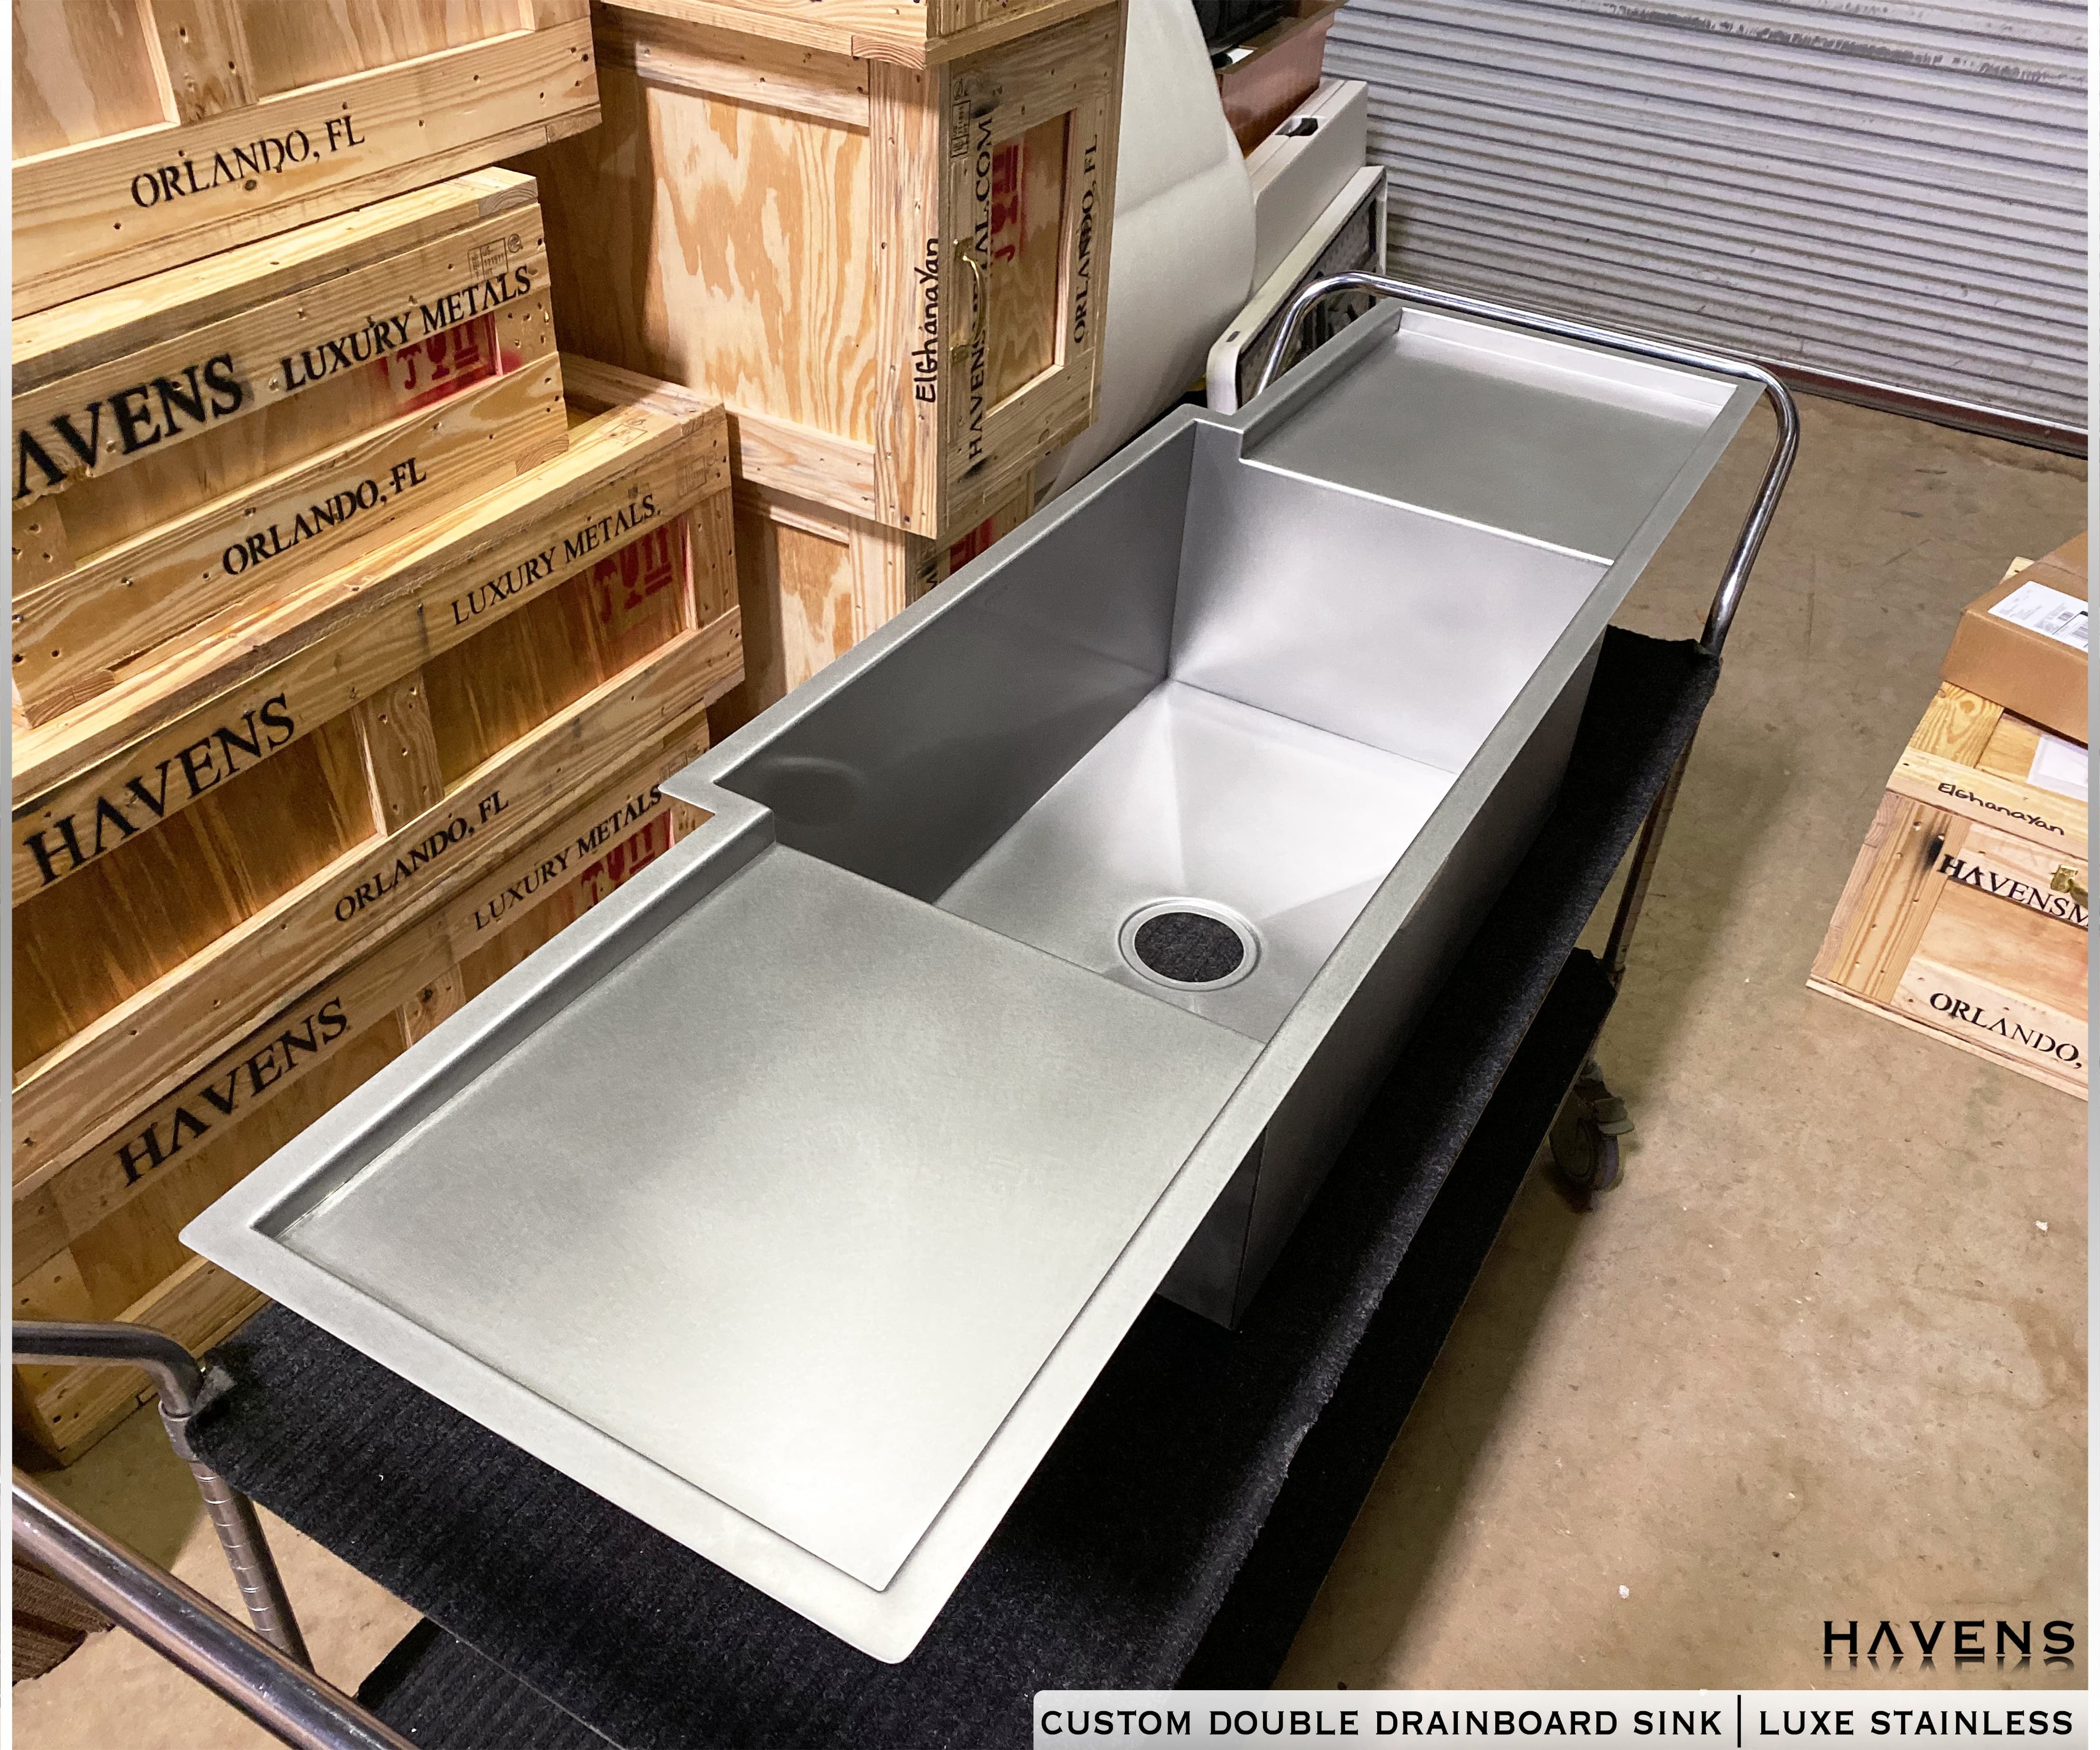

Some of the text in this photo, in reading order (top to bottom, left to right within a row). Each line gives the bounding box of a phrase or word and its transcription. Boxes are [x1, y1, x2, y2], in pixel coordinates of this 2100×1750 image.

[131, 114, 365, 208] ORLANDO, FL
[1073, 134, 1098, 343] ORLANDO, FL
[282, 311, 410, 389] LUXURY
[422, 266, 531, 333] METALS
[223, 457, 426, 575] ORLANDO, FL
[452, 547, 557, 625] LUXURY
[23, 693, 296, 886] HAVENS
[335, 791, 510, 923] ORLANDO, FL
[474, 783, 662, 931] LUXURY METALS
[1937, 854, 2088, 927] HAVENSM
[115, 996, 349, 1188] HAVENS
[1930, 992, 2083, 1069] ORLANDO,
